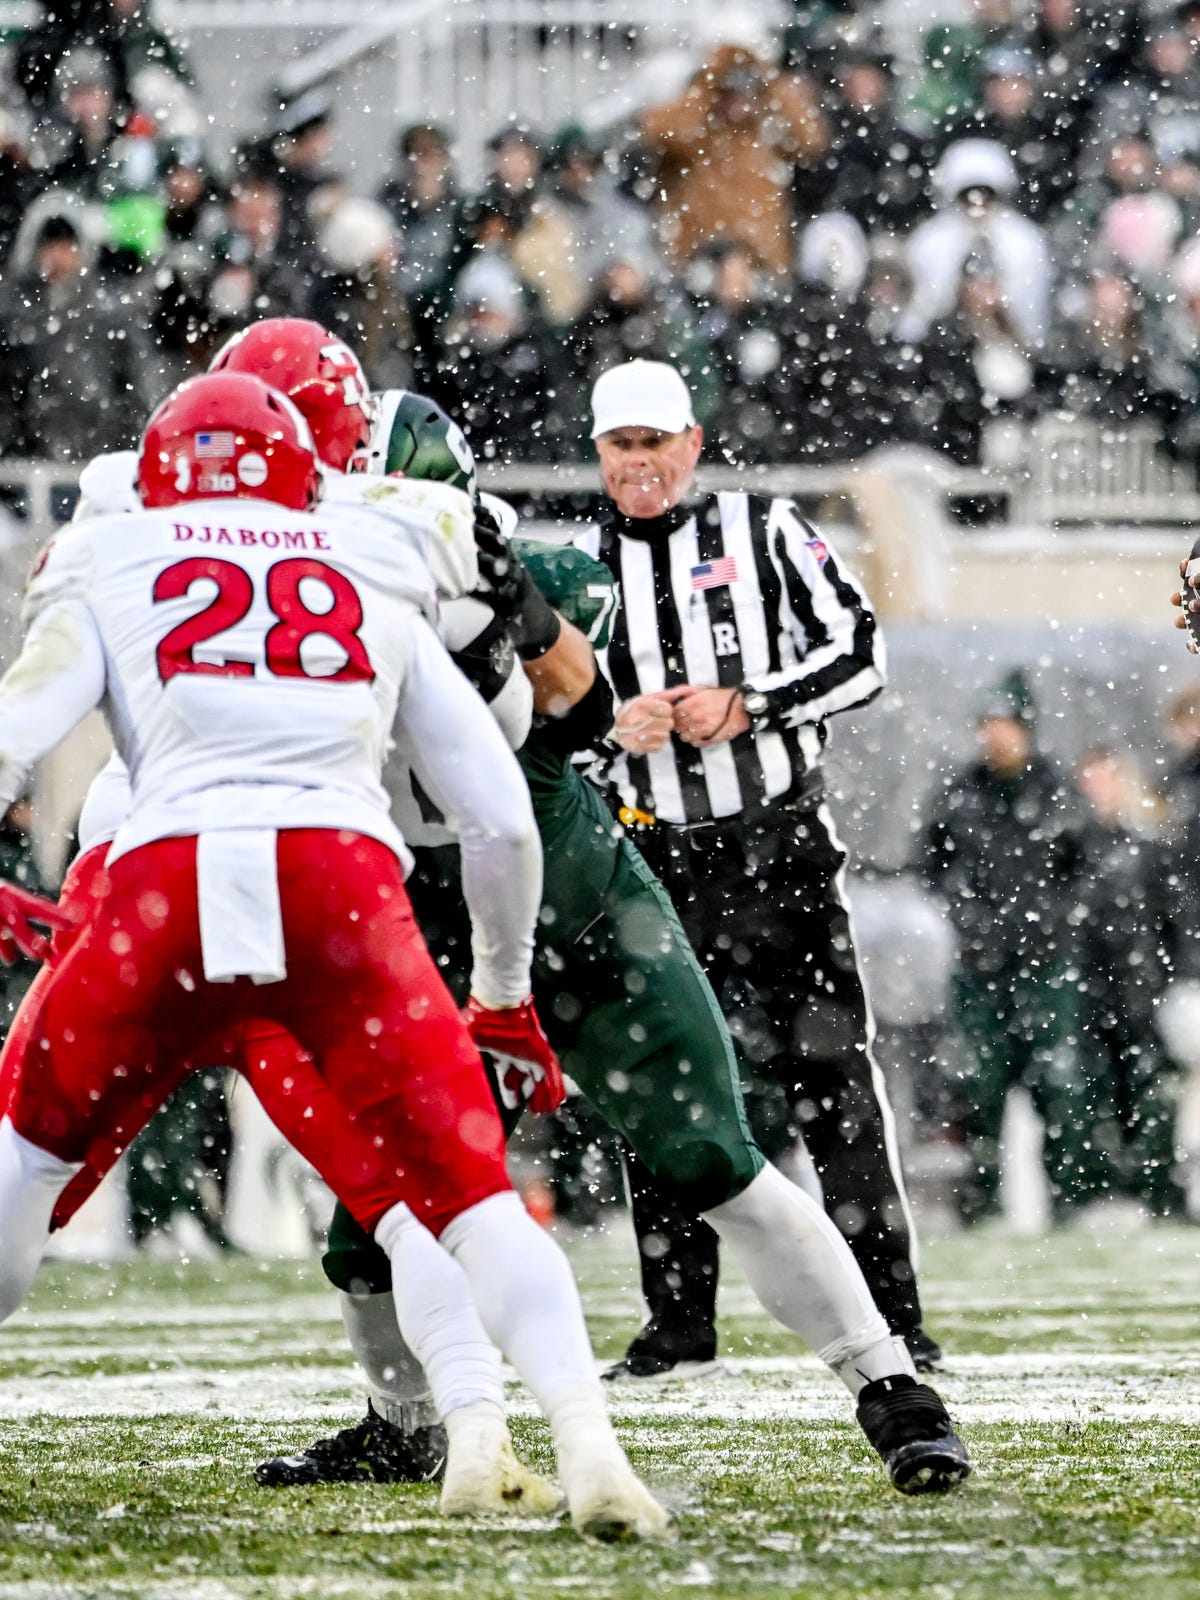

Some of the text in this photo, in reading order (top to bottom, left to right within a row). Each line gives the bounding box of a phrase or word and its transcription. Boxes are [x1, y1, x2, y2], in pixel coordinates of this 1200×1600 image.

[172, 523, 332, 551] DJABOME
[152, 556, 376, 684] 28
[713, 622, 740, 656] R
